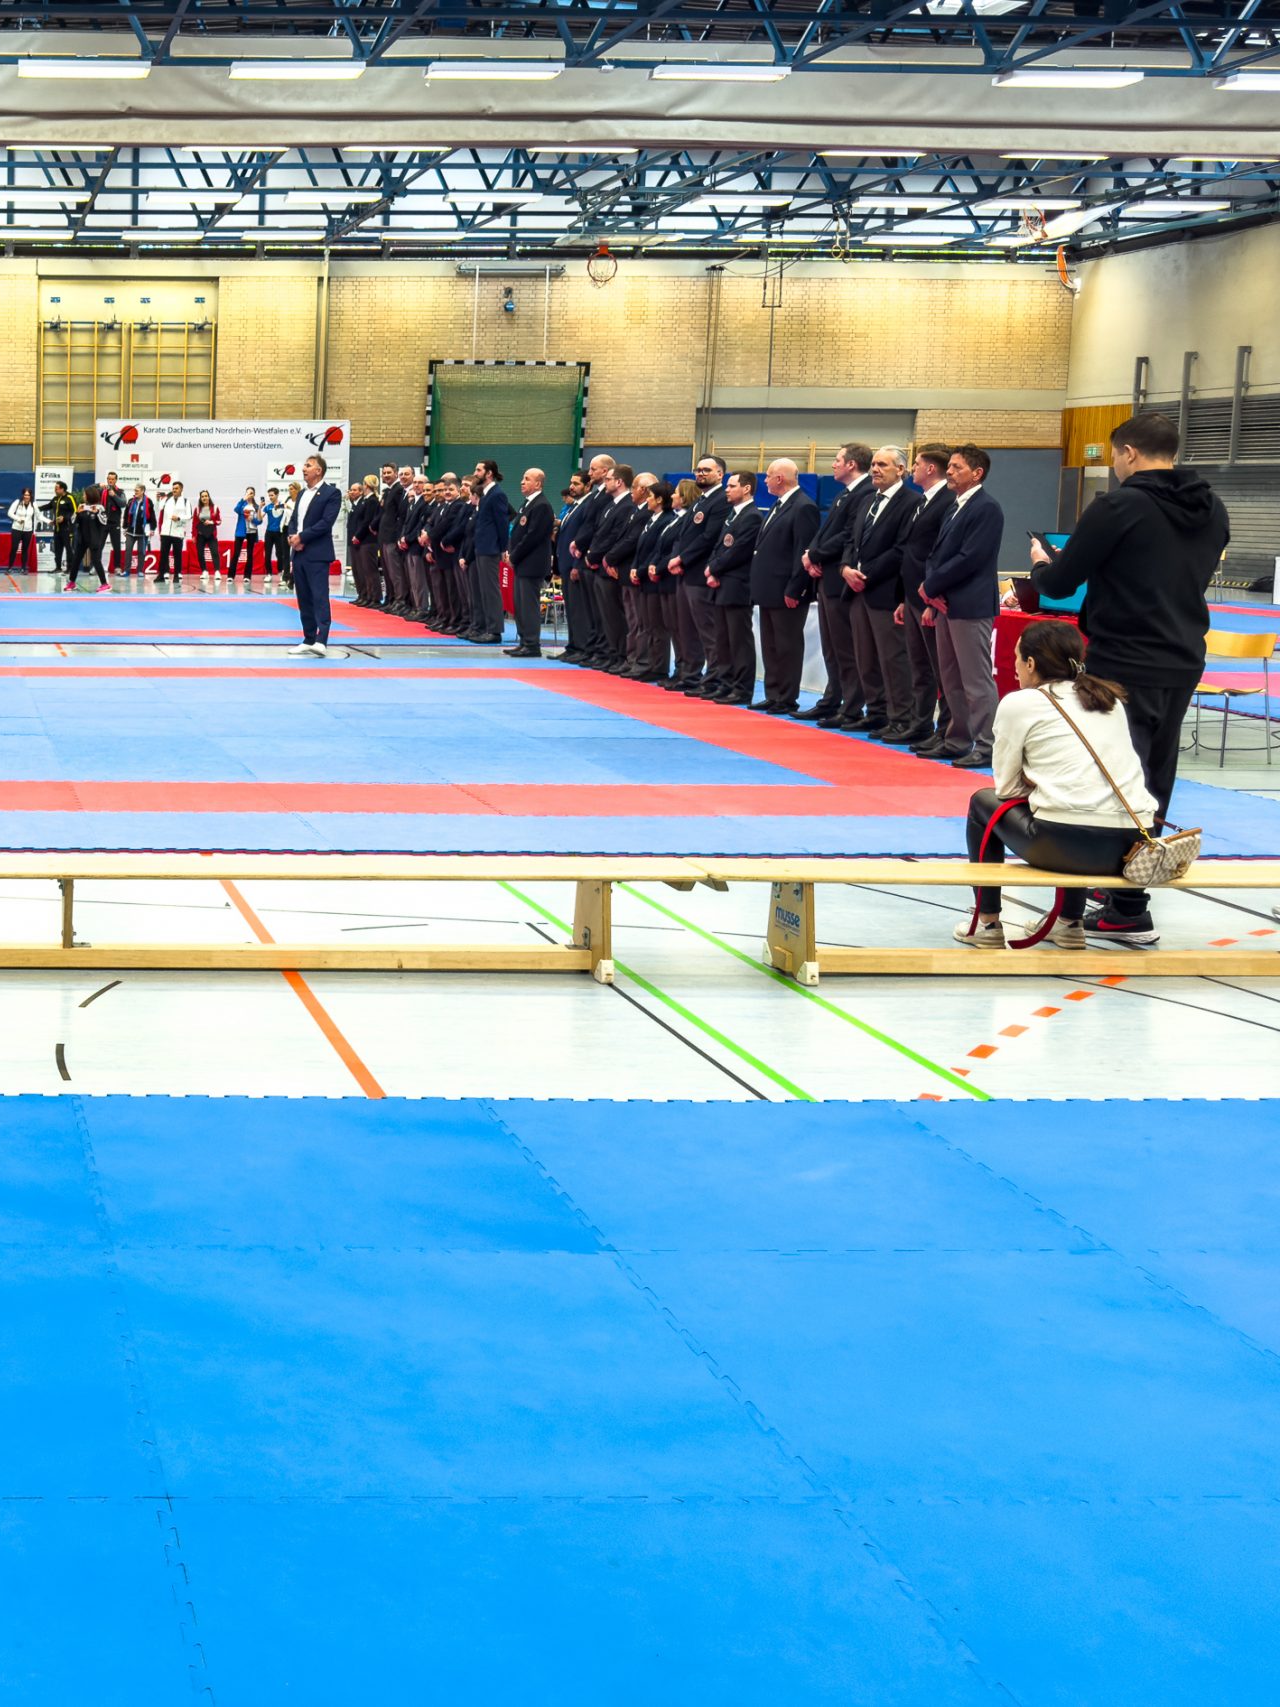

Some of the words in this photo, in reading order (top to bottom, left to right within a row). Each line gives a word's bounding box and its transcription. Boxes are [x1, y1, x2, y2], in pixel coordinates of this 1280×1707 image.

[143, 426, 166, 434] Karate
[167, 426, 214, 434] Dachverband
[215, 427, 289, 435] Nordrhein-Westfalen
[289, 427, 302, 435] e.V.
[233, 442, 284, 450] Unterstützern.
[144, 554, 158, 573] 2
[222, 549, 231, 568] 1
